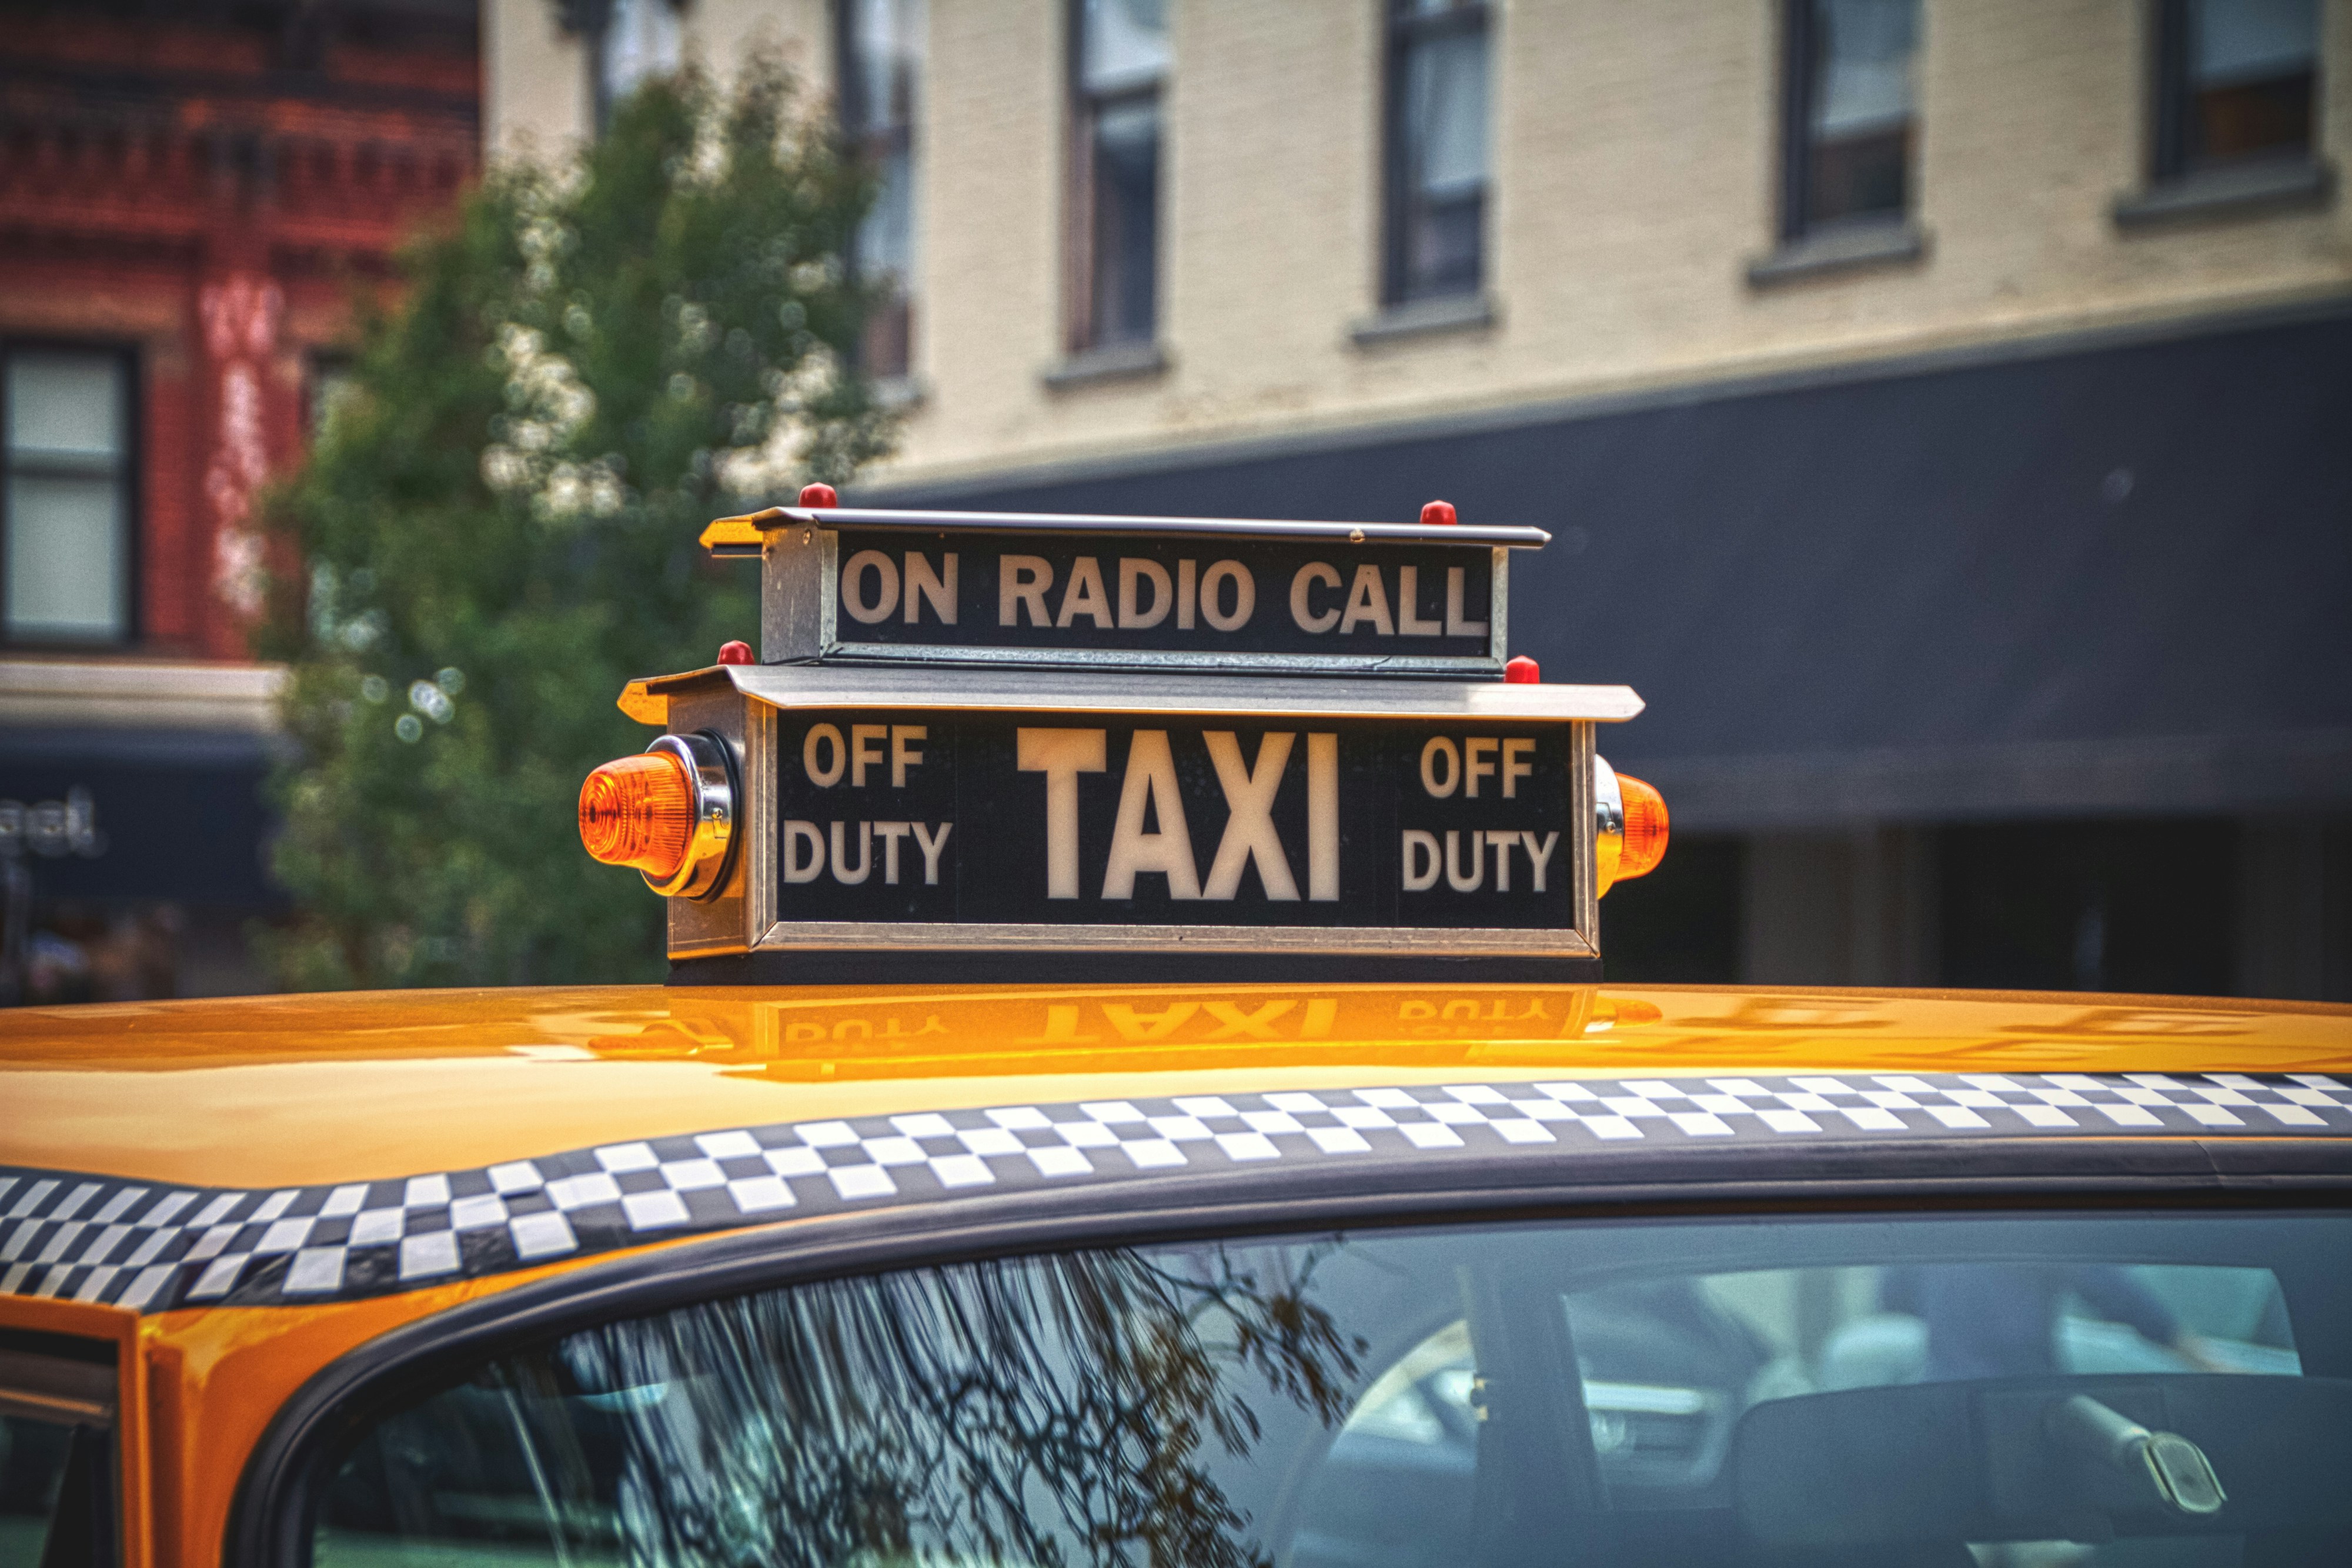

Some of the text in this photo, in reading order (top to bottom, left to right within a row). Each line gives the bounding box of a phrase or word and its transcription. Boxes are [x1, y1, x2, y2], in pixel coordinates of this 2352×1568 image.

[841, 550, 1489, 636] ON RADIO CALL
[803, 723, 927, 787] OFF
[1421, 736, 1536, 798] OFF
[1017, 727, 1339, 901] TAXI
[783, 820, 953, 885] DUTY
[1402, 830, 1559, 892] DUTY
